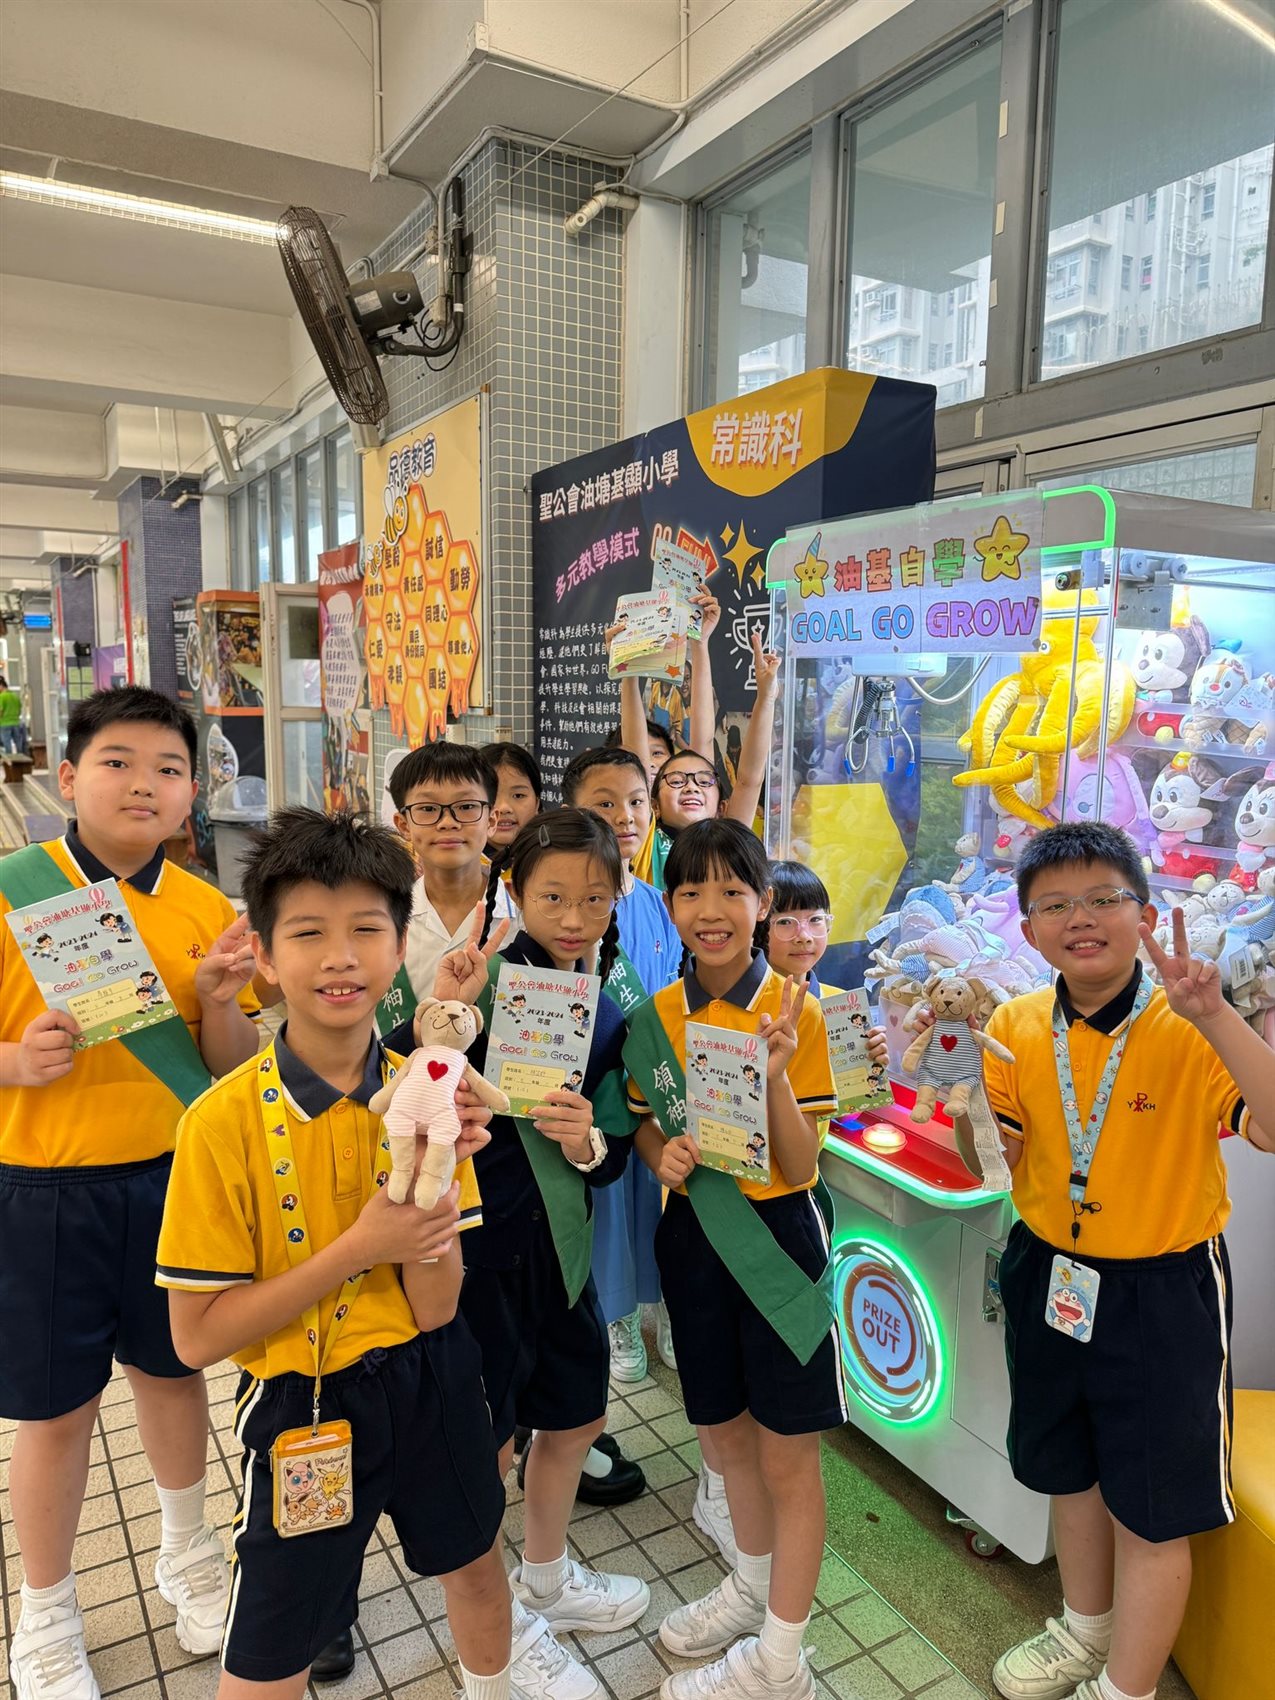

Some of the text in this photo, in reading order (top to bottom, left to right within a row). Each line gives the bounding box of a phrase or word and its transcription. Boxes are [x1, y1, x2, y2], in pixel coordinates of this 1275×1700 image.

[711, 408, 803, 468] 常識科
[539, 449, 679, 521] 聖公會油塘基顯小學
[450, 566, 471, 592] 勤勞
[555, 526, 640, 603] 多元教學模式
[833, 538, 966, 593] 油基自學
[425, 604, 448, 623] 同理心
[791, 596, 1039, 643] GOAL GO GROW
[107, 960, 139, 975] Grow
[608, 962, 640, 1011] 袖生
[550, 1050, 579, 1062] Grow
[652, 1060, 687, 1134] 領袖
[733, 1110, 757, 1125] Grow
[862, 1318, 901, 1354] OUT
[863, 1298, 901, 1334] PRIZE
